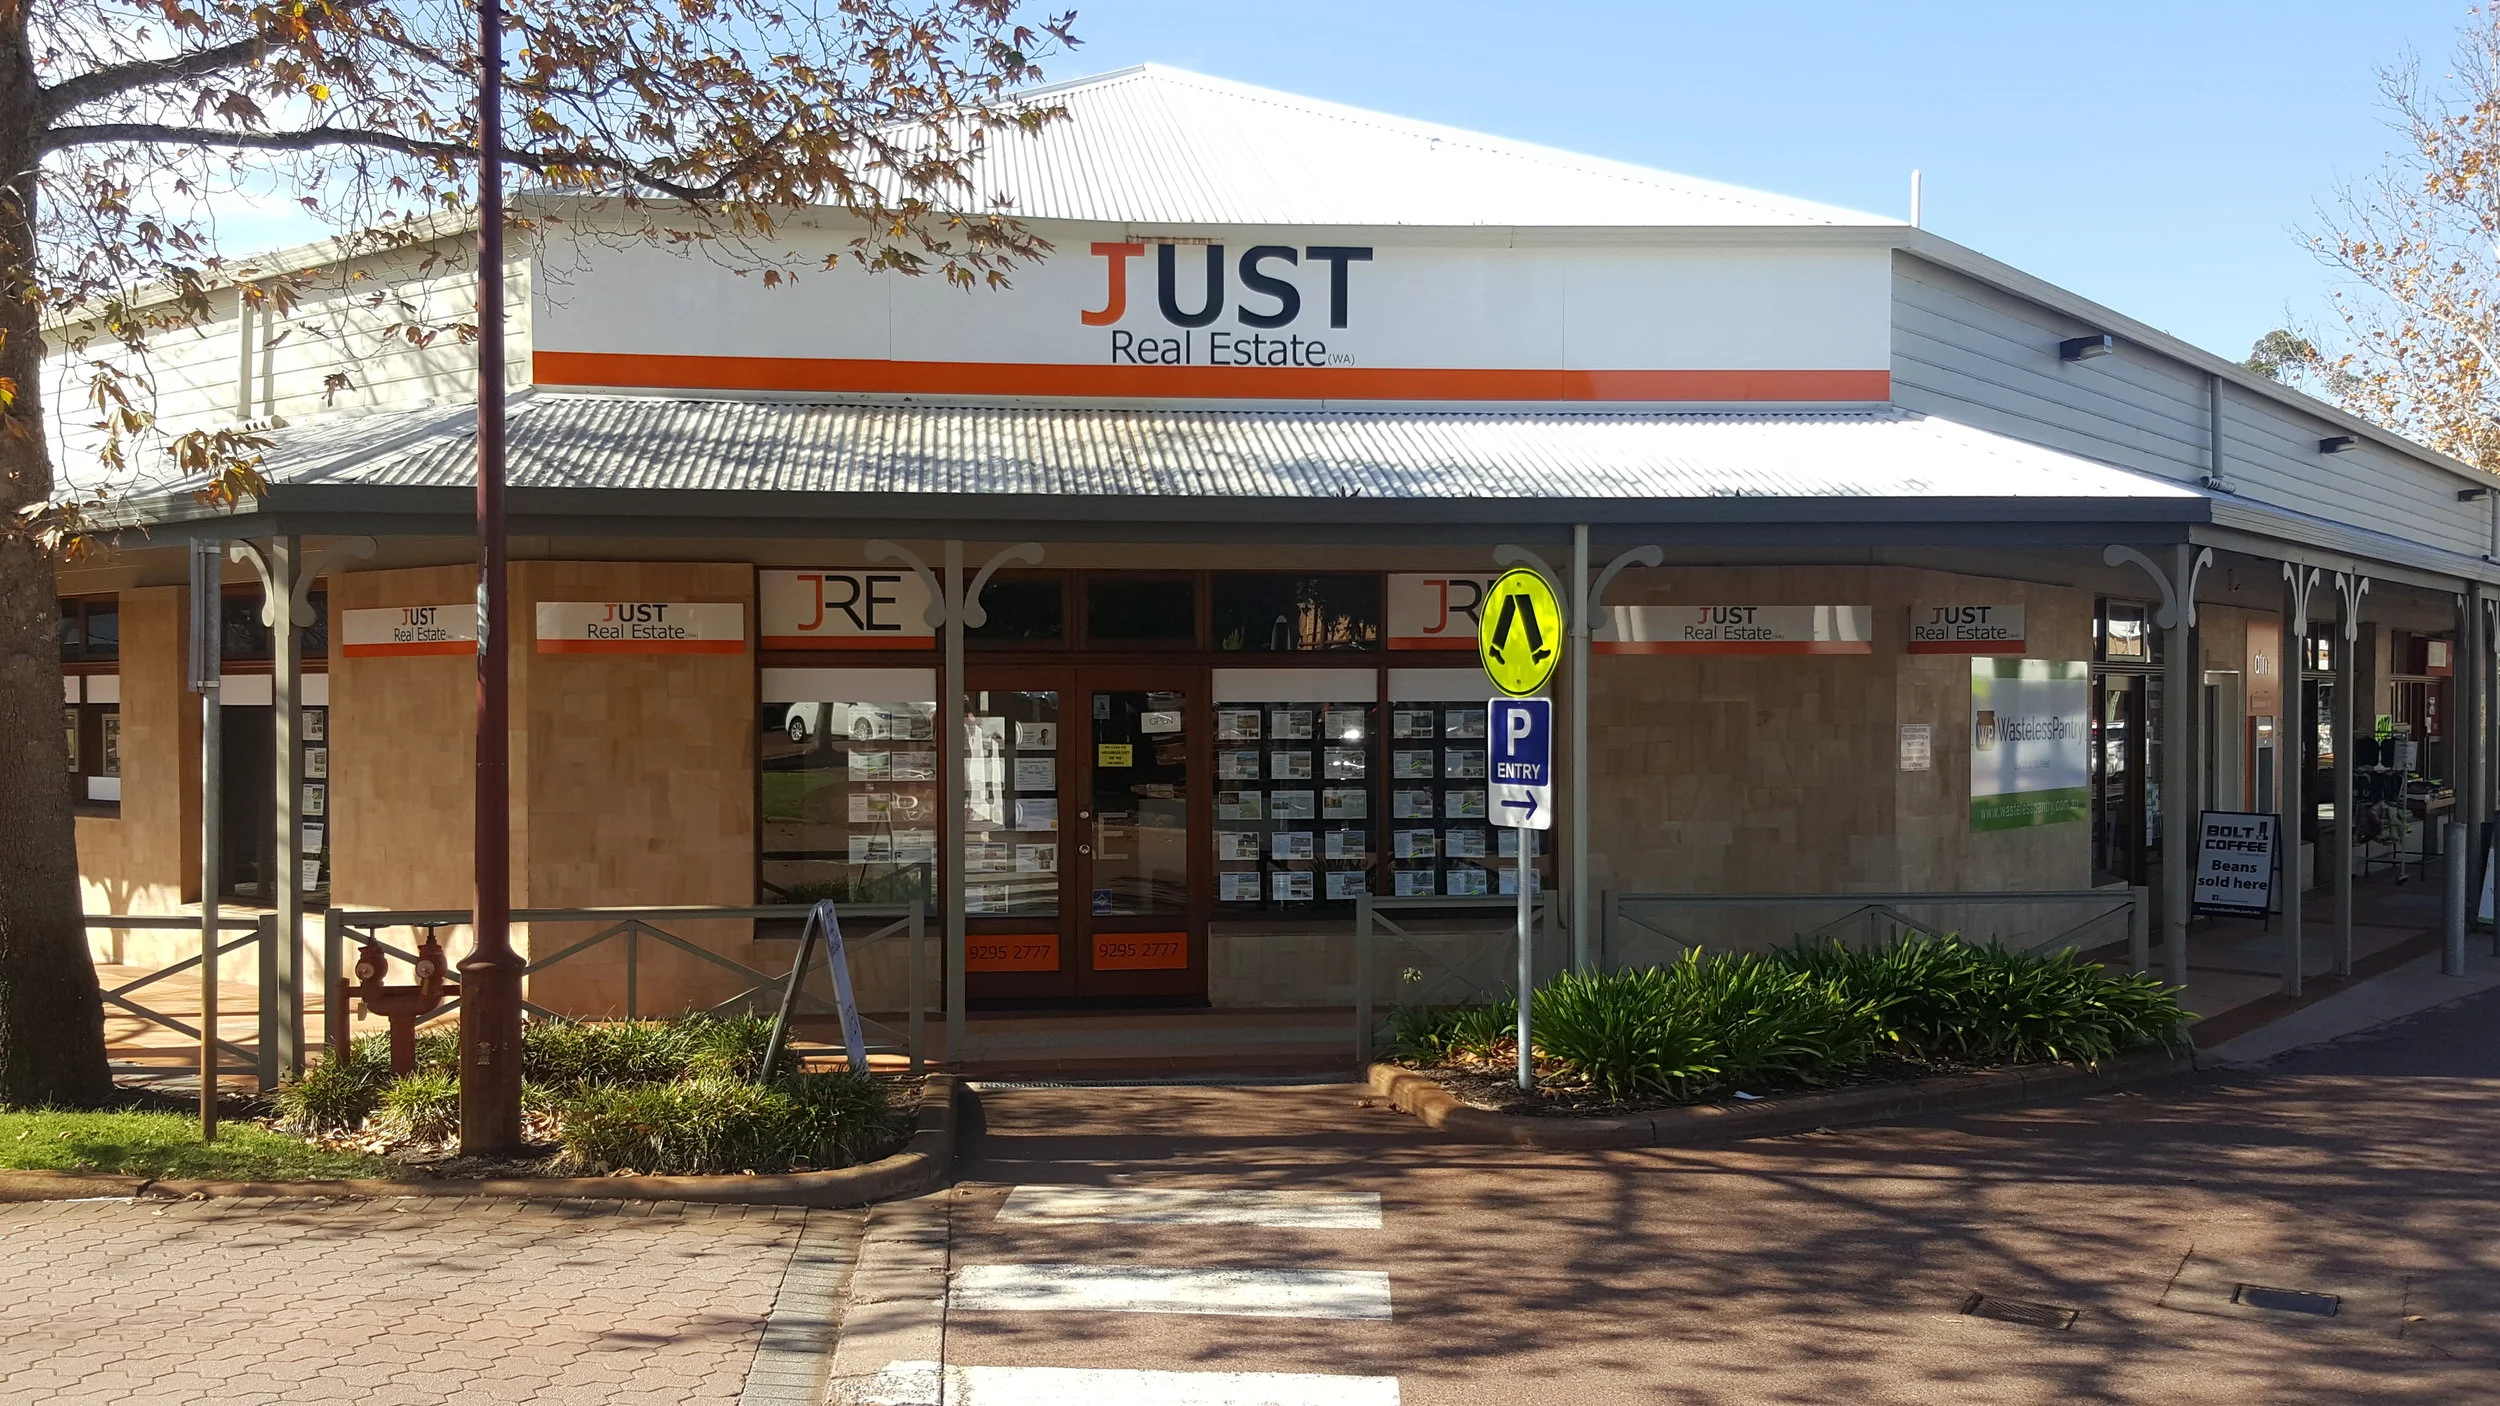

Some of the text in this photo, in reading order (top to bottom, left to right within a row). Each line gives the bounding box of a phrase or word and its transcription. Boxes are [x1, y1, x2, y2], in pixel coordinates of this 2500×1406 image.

[1081, 242, 1373, 329] JUST
[1112, 330, 1191, 365] Real
[1210, 332, 1327, 367] Estate
[797, 575, 901, 631] JRE
[1423, 580, 1497, 634] JR
[402, 608, 437, 626] JUST
[602, 604, 668, 622] JUST
[1698, 607, 1757, 624] JUST
[1930, 607, 1991, 624] JUST
[394, 627, 447, 642] Real Estate
[588, 624, 624, 639] Real
[632, 624, 685, 639] Estate
[1684, 625, 1717, 640] Real
[1724, 626, 1772, 640] Estate
[1915, 625, 1949, 640] Real
[1957, 625, 2007, 640] Estate
[1507, 708, 1532, 756] P
[1977, 725, 1994, 745] WP
[1497, 762, 1541, 780] ENTRY
[2207, 825, 2254, 838] BOLT
[2205, 839, 2267, 853] COFFEE
[2212, 860, 2257, 873] Beans
[2197, 876, 2268, 890] sold here
[969, 945, 1050, 960] 9295 2777
[1099, 942, 1179, 958] 9295 2777
